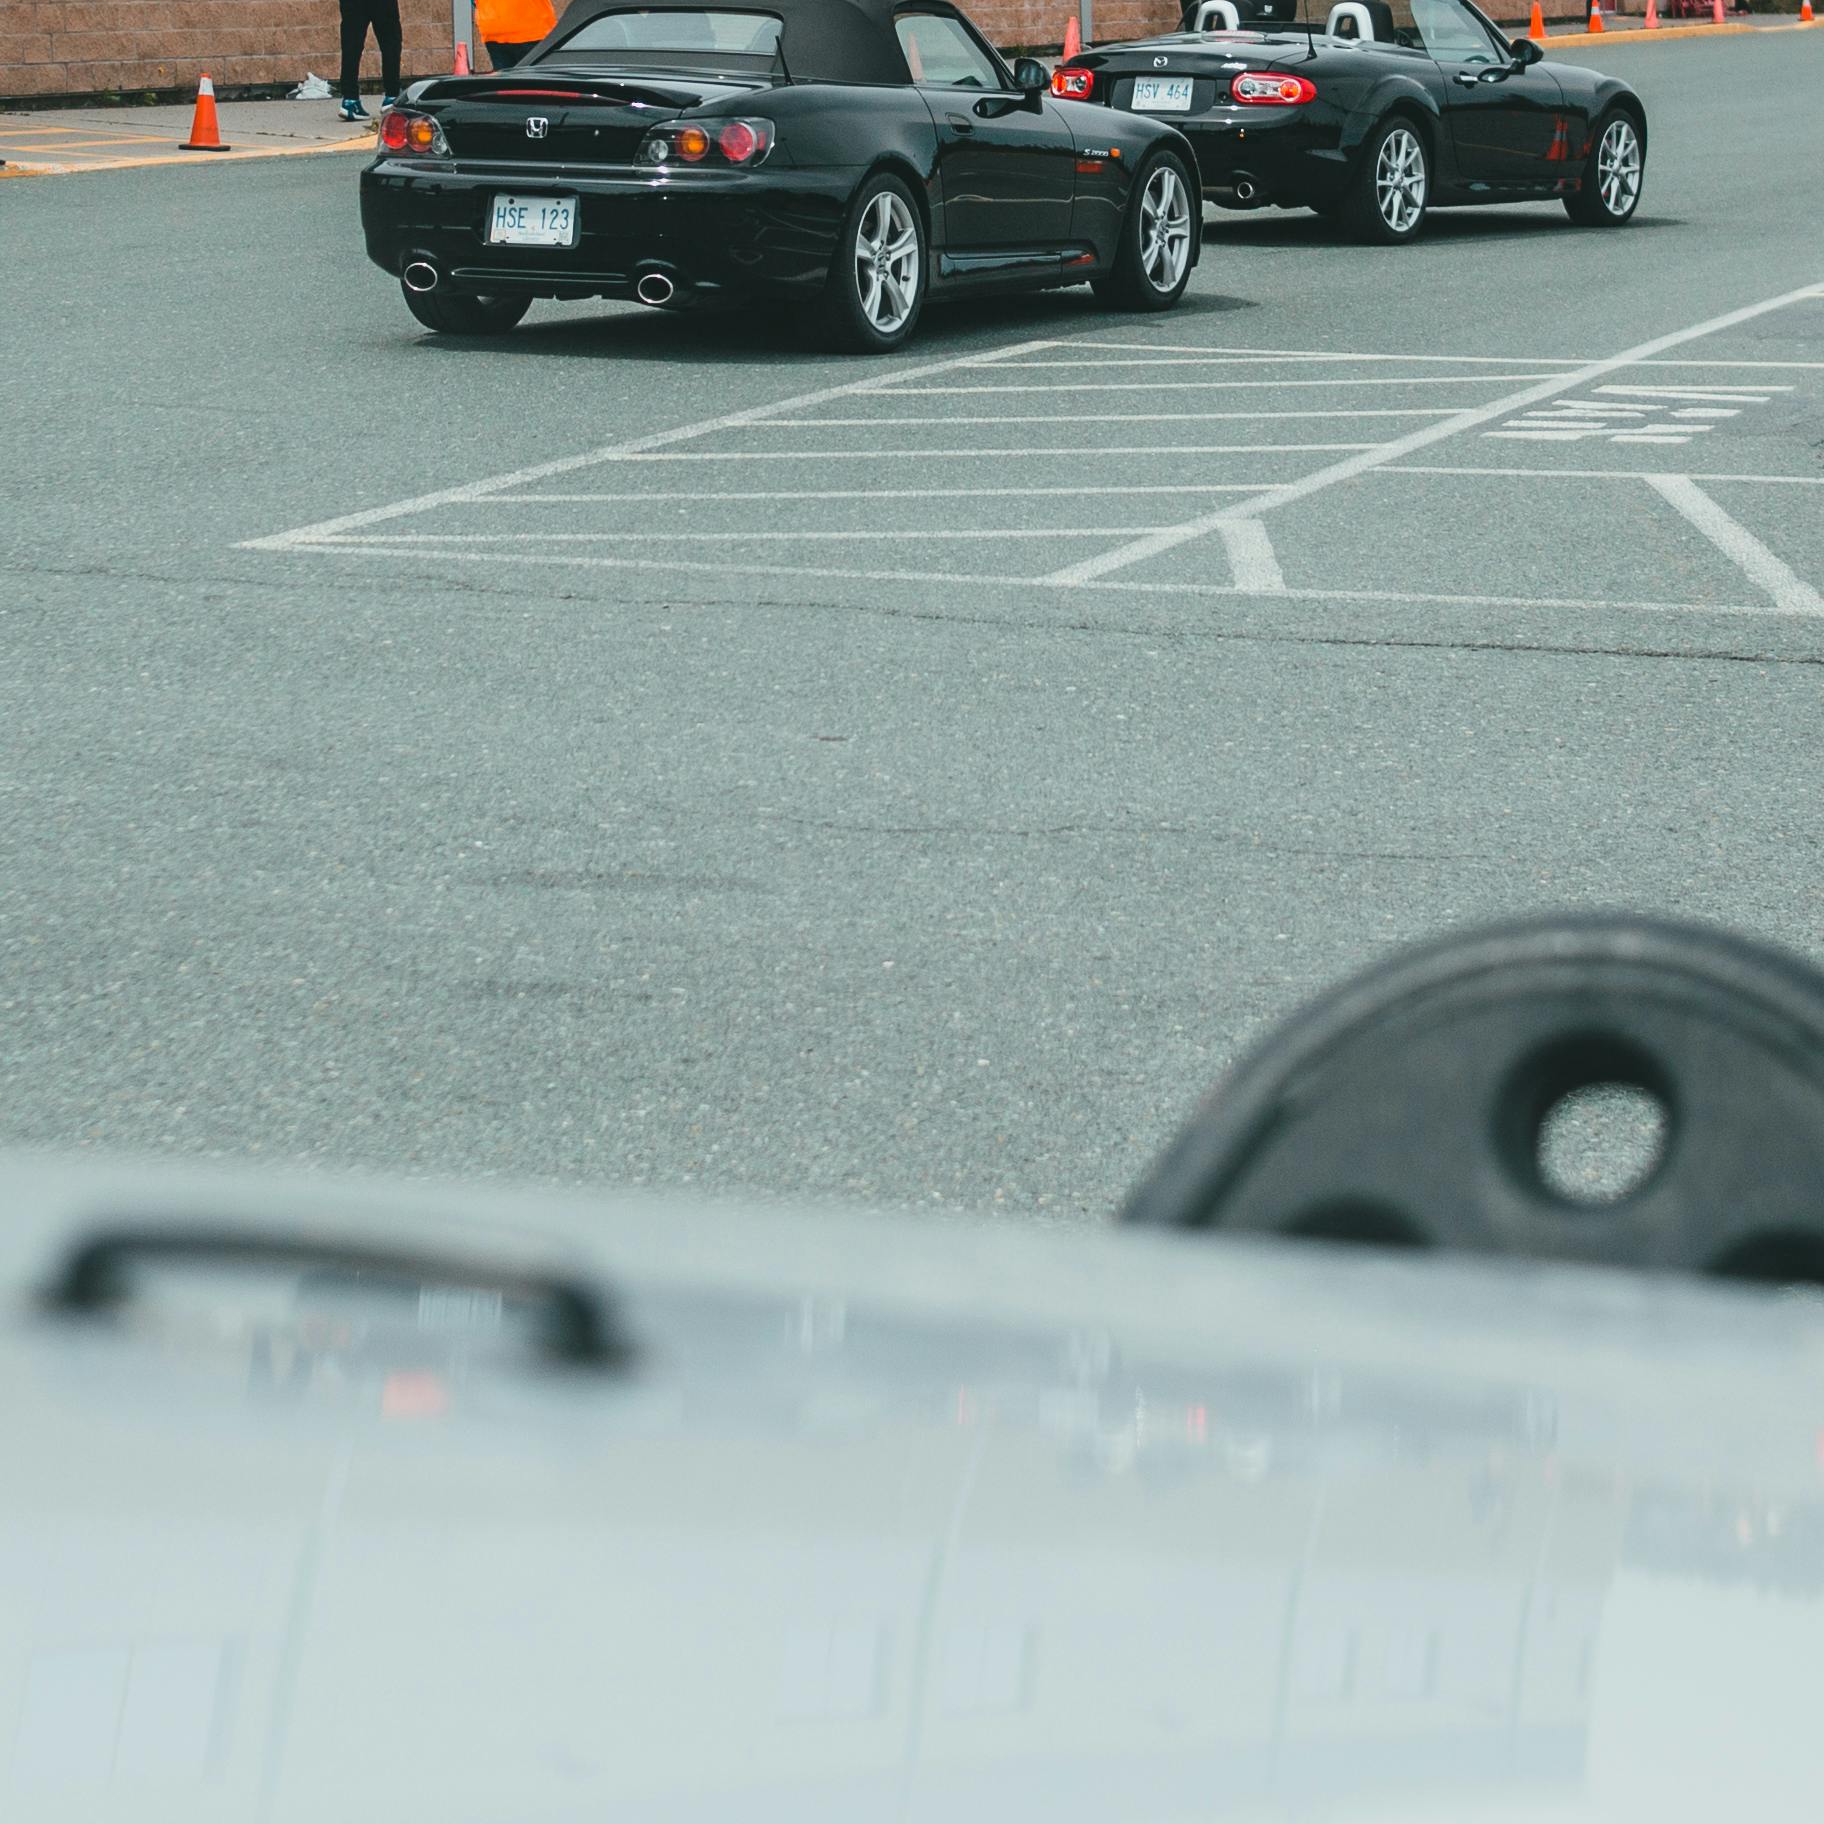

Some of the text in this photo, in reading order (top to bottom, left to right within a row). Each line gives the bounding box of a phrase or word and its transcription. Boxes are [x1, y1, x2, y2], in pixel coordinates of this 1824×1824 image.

[1136, 83, 1190, 99] HSV 464
[496, 206, 570, 230] HSE 123
